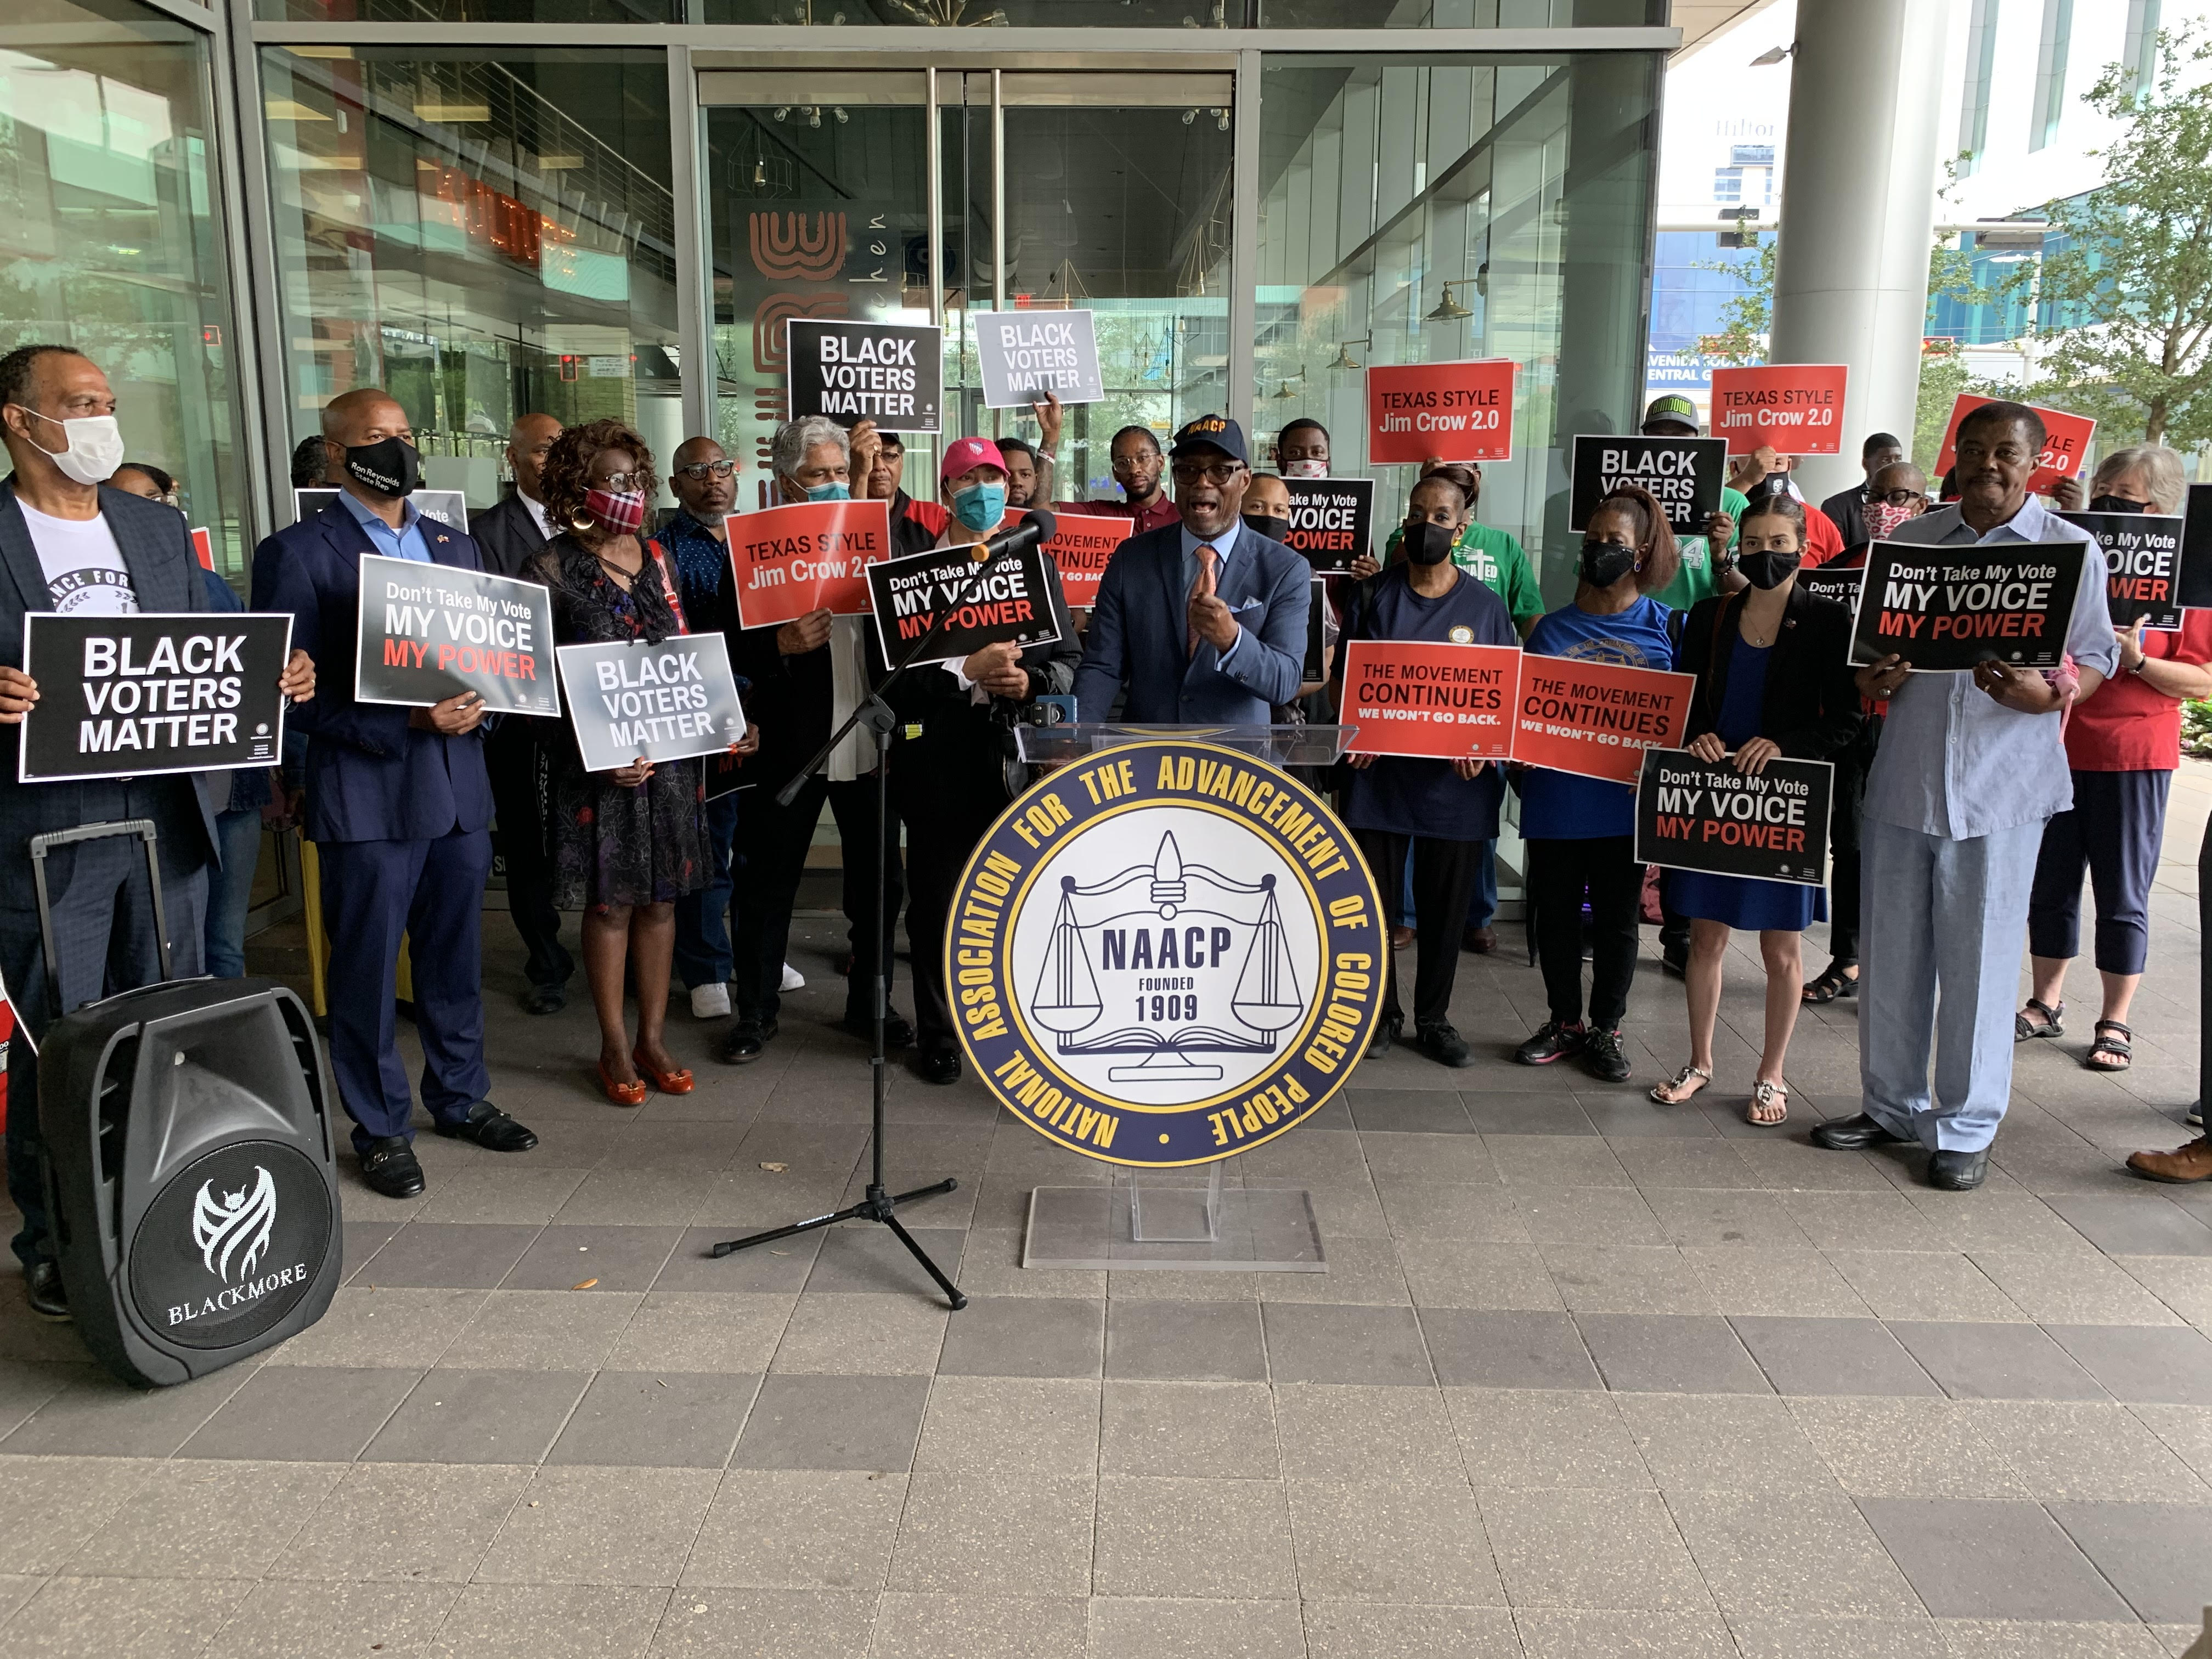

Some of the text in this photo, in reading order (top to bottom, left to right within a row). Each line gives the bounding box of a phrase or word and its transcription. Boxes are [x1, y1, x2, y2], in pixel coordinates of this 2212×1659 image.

[1000, 323, 1075, 348] BLACK
[820, 336, 916, 366] BLACK
[1003, 348, 1078, 369] VOTERS
[1647, 355, 1700, 366] VENIDA
[820, 365, 916, 391] VOTERS
[1007, 369, 1081, 392] MATTER
[1647, 369, 1699, 381] ENTRAL
[821, 391, 915, 416] MATTER
[1381, 390, 1499, 409] TEXAS STYLE
[1724, 390, 1833, 406] TEXAS STYLE
[1188, 420, 1226, 435] NAACP
[1379, 410, 1499, 433] Jim Crow 2.0
[1720, 408, 1832, 428] Jim Crow 2.0
[351, 461, 400, 487] Ron Reynolds
[1601, 449, 1699, 476] BLACK
[2040, 451, 2069, 471] 2.0
[355, 472, 389, 491] State Rep
[1289, 493, 1357, 508] ake My Vote
[1288, 508, 1356, 530] VOICE
[746, 532, 876, 562] TEXAS STYLE
[1045, 533, 1119, 549] OVEMENT
[1282, 531, 1354, 550] POWER
[2095, 531, 2176, 549] ke My Vote
[748, 565, 786, 590] Jim
[791, 559, 847, 582] Crow
[1889, 562, 2057, 582] Don't Take My Vote
[2104, 549, 2173, 577] OICE
[889, 570, 929, 591] Don't
[930, 564, 964, 582] Take
[1066, 572, 1083, 582] GO
[1809, 582, 1861, 594] Don't Ta
[2111, 577, 2169, 602] WER
[386, 582, 532, 620] Don't Take My Vote
[893, 574, 1028, 617] MY VOICE
[1883, 582, 1938, 611] MY
[1946, 583, 2052, 612] VOICE
[385, 603, 533, 652] MY VOICE
[898, 600, 1034, 640] MY POWER
[1878, 611, 2046, 640] MY POWER
[84, 635, 247, 678] BLACK
[383, 639, 536, 681] MY POWER
[596, 652, 703, 691] BLACK
[1363, 664, 1503, 685] THE MOVEMENT
[83, 676, 241, 715] VOTERS
[602, 684, 708, 719] VOTERS
[1358, 682, 1501, 709] CONTINUES
[1532, 678, 1674, 711] THE MOVEMENT
[1358, 708, 1501, 726] WE WON'T GO BACK.
[1524, 696, 1670, 736] CONTINUES
[79, 713, 238, 753] MATTER
[609, 712, 715, 748] MATTER
[1521, 719, 1543, 732] WE
[1546, 724, 1595, 742] WON'T
[1597, 733, 1620, 746] GO
[1660, 769, 1809, 796] Don't Take My Vote
[1657, 787, 1807, 826] MY VOICE
[1656, 815, 1805, 853] MY POWER
[957, 755, 1372, 1149] NATIONAL ASSOCIATION FOR THE ADVANCEMENT OF COLORED PEOPLE
[1103, 927, 1231, 970] NAACP
[1139, 977, 1194, 991] FOUNDED
[1136, 994, 1197, 1022] 1909
[168, 1263, 307, 1326] BLACKMORE
